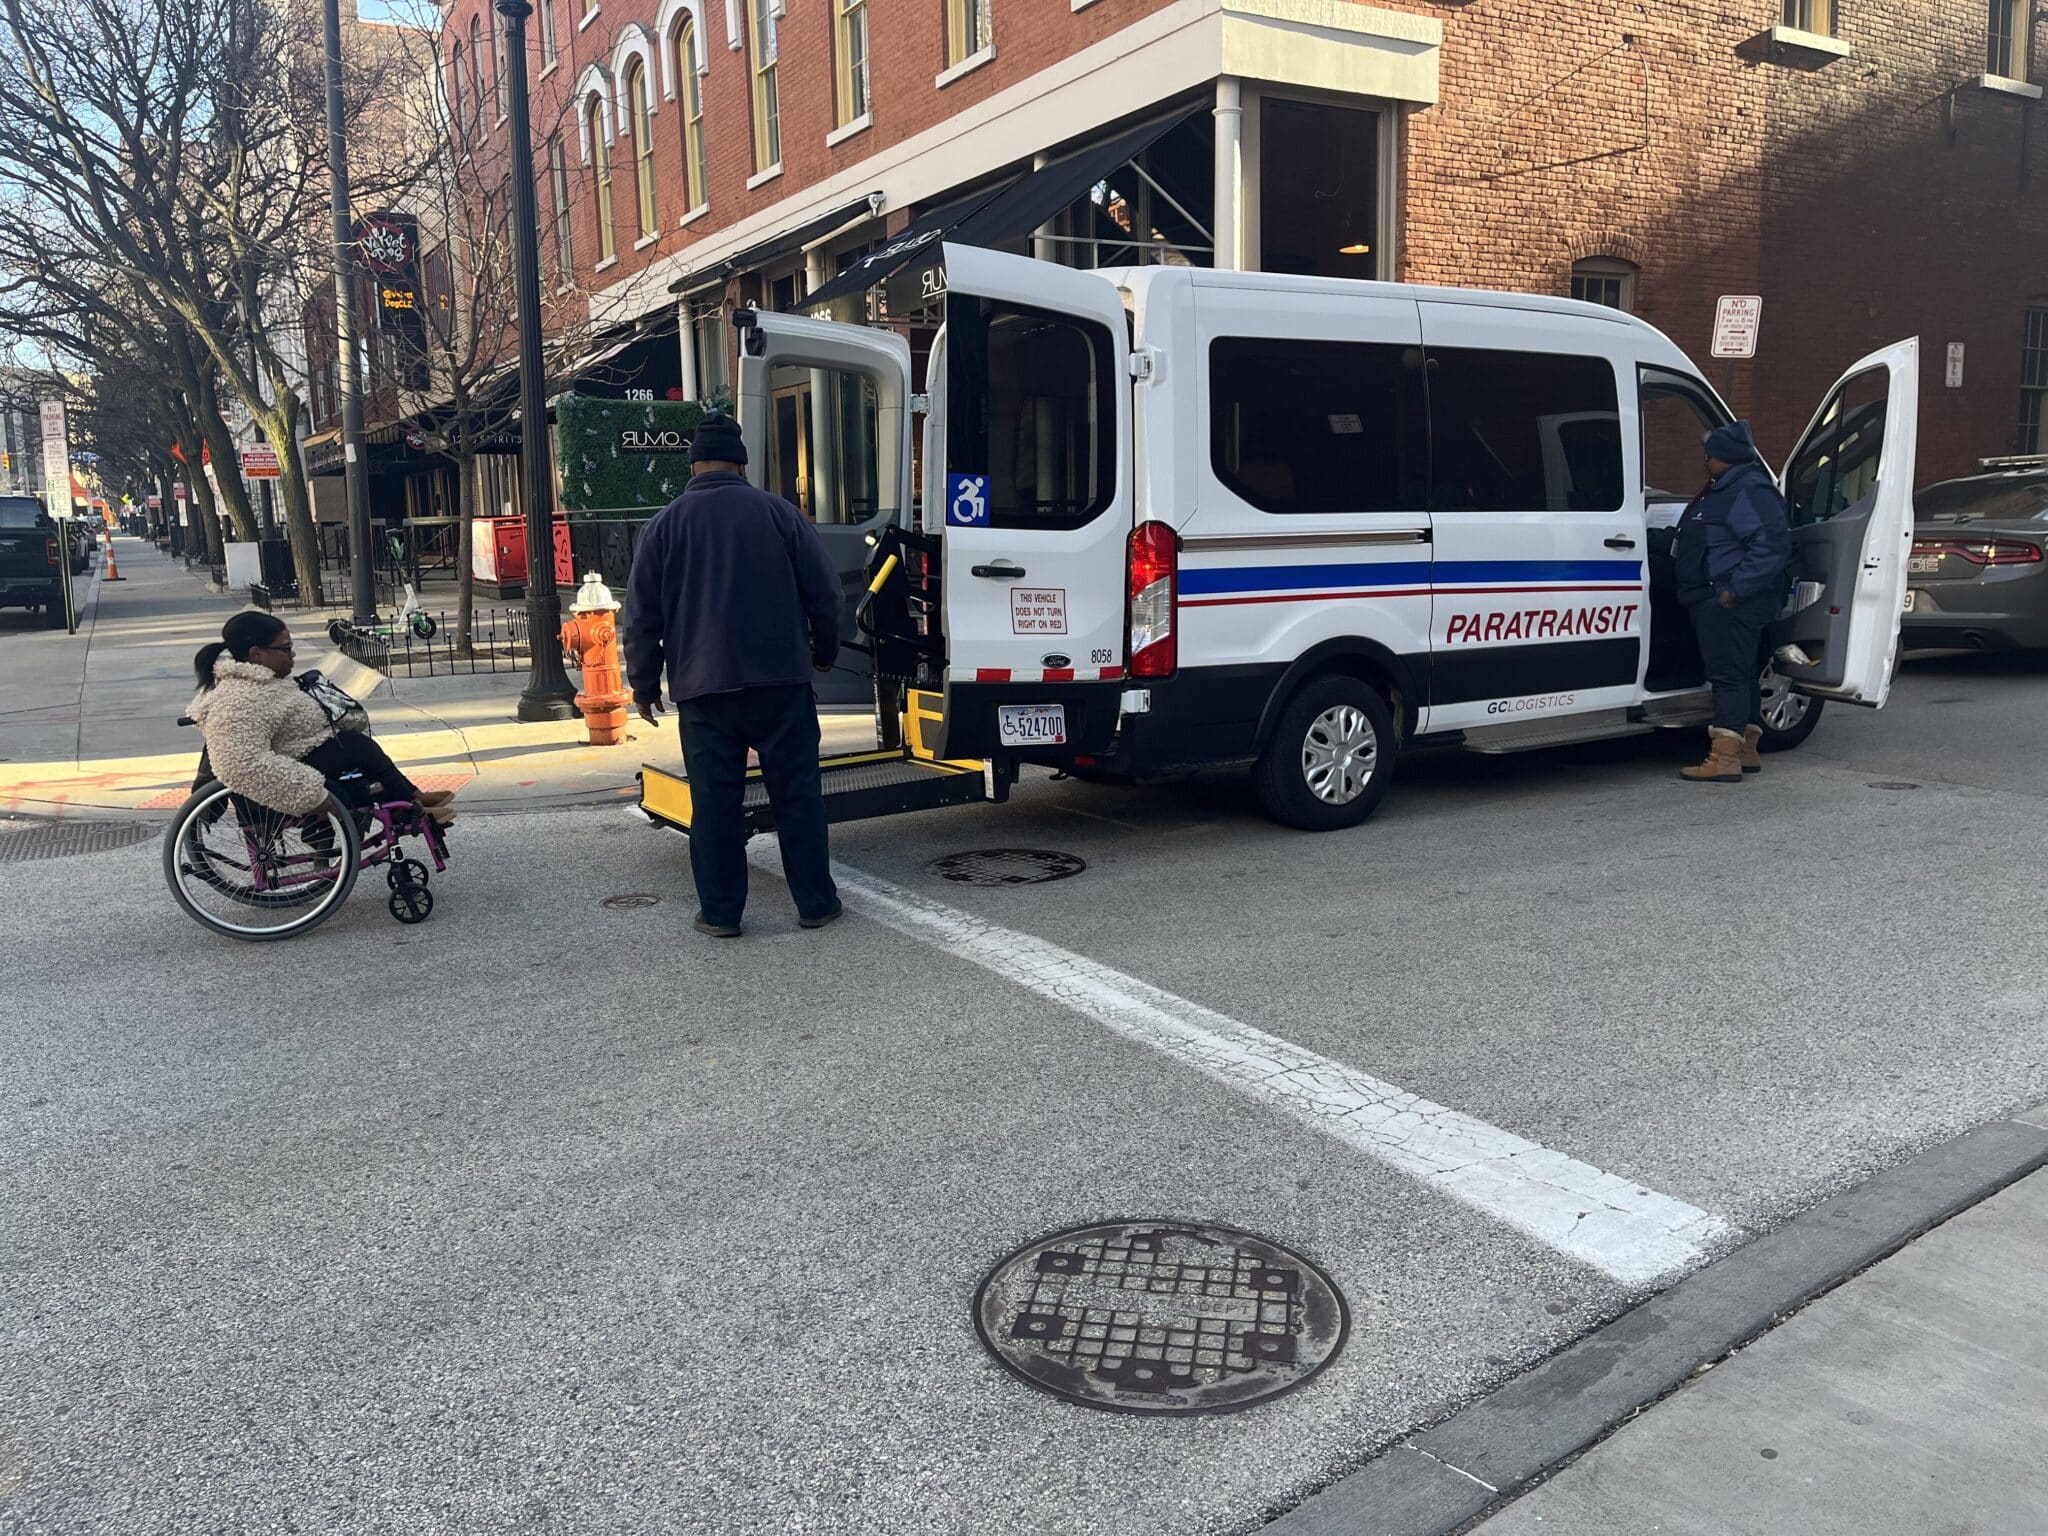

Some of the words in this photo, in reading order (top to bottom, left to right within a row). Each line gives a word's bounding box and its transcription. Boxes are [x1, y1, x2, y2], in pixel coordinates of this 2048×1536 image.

[1731, 300, 1747, 308] NO
[625, 389, 653, 401] 1266
[1020, 593, 1033, 603] THIS
[1034, 593, 1057, 603] VEHICLE
[1015, 607, 1032, 616] DOES
[1034, 607, 1045, 616] NOT
[1046, 607, 1063, 617] TURN
[1018, 619, 1036, 629] RIGHT
[1038, 620, 1048, 629] ON
[1049, 620, 1062, 629] RED
[1446, 604, 1639, 644] PARATRANSIT
[1091, 649, 1113, 664] 8058
[1199, 1302, 1251, 1314] DEPT
